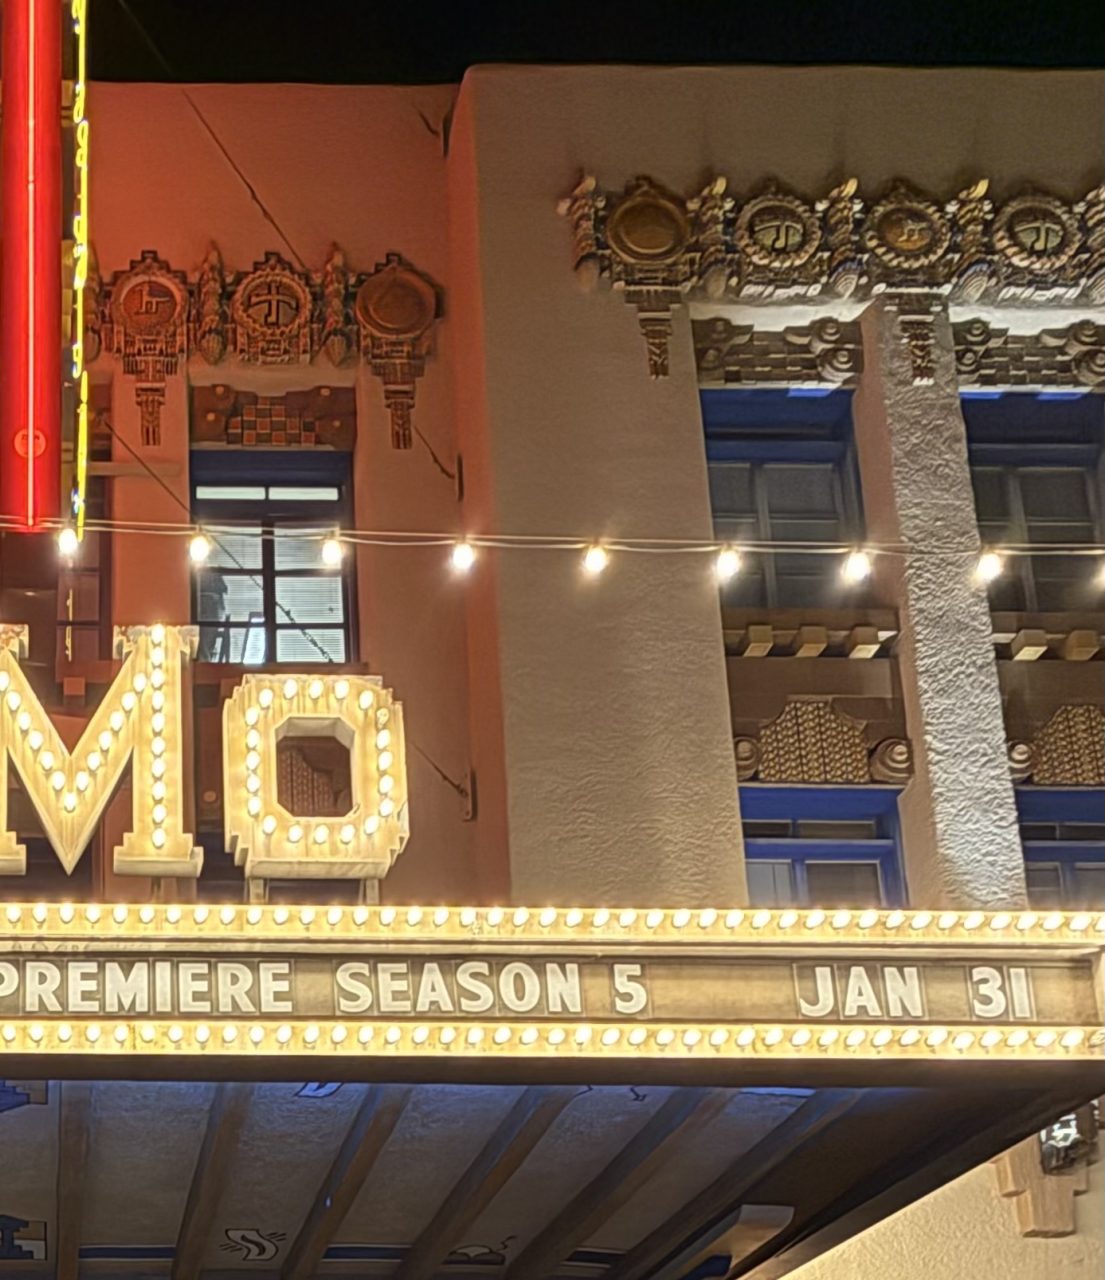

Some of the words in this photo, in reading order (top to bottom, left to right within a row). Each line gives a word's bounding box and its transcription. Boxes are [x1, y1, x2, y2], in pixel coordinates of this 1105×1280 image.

[335, 960, 583, 1015] SEASON
[612, 963, 649, 1015] 5
[798, 965, 925, 1018] JAN
[970, 965, 1032, 1019] 31
